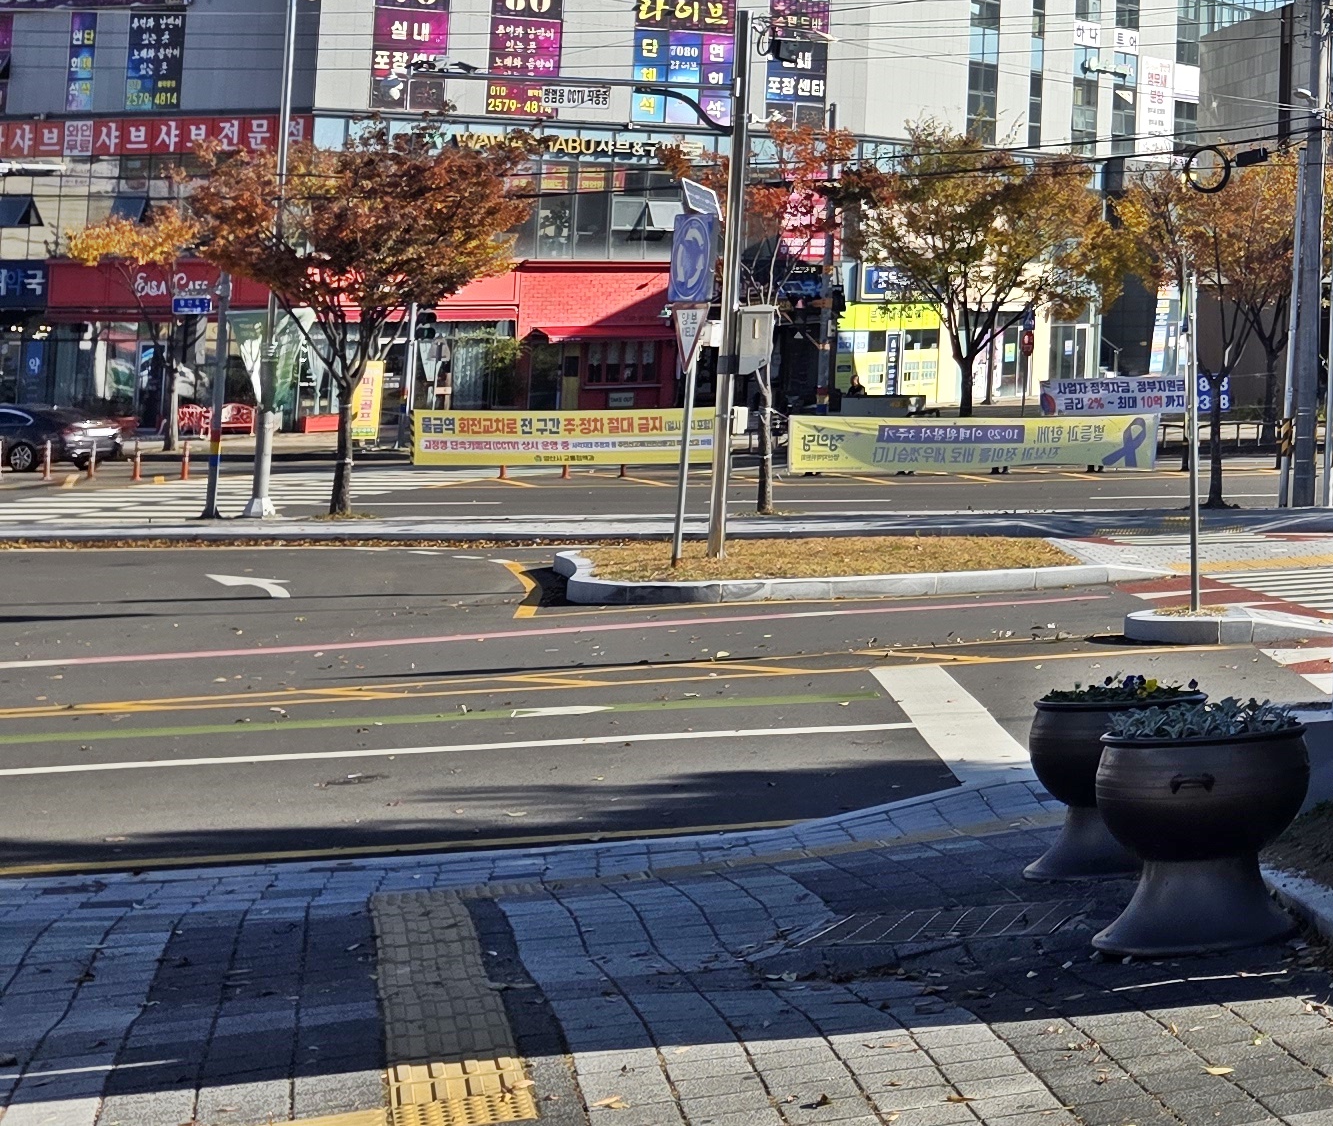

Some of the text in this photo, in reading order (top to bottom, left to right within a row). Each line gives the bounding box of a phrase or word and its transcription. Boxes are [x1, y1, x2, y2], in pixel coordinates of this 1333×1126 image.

[566, 89, 587, 105] CCTV
[1056, 381, 1089, 395] 사업자
[1136, 379, 1186, 393] 정부지원금
[1063, 394, 1185, 411] 금리 2% 최대 10억 까지
[421, 416, 456, 434] 물금역
[458, 416, 518, 435] 회전교차로
[520, 417, 534, 435] 전
[536, 417, 561, 436] 구간
[606, 416, 634, 434] 절대
[637, 415, 663, 433] 금지
